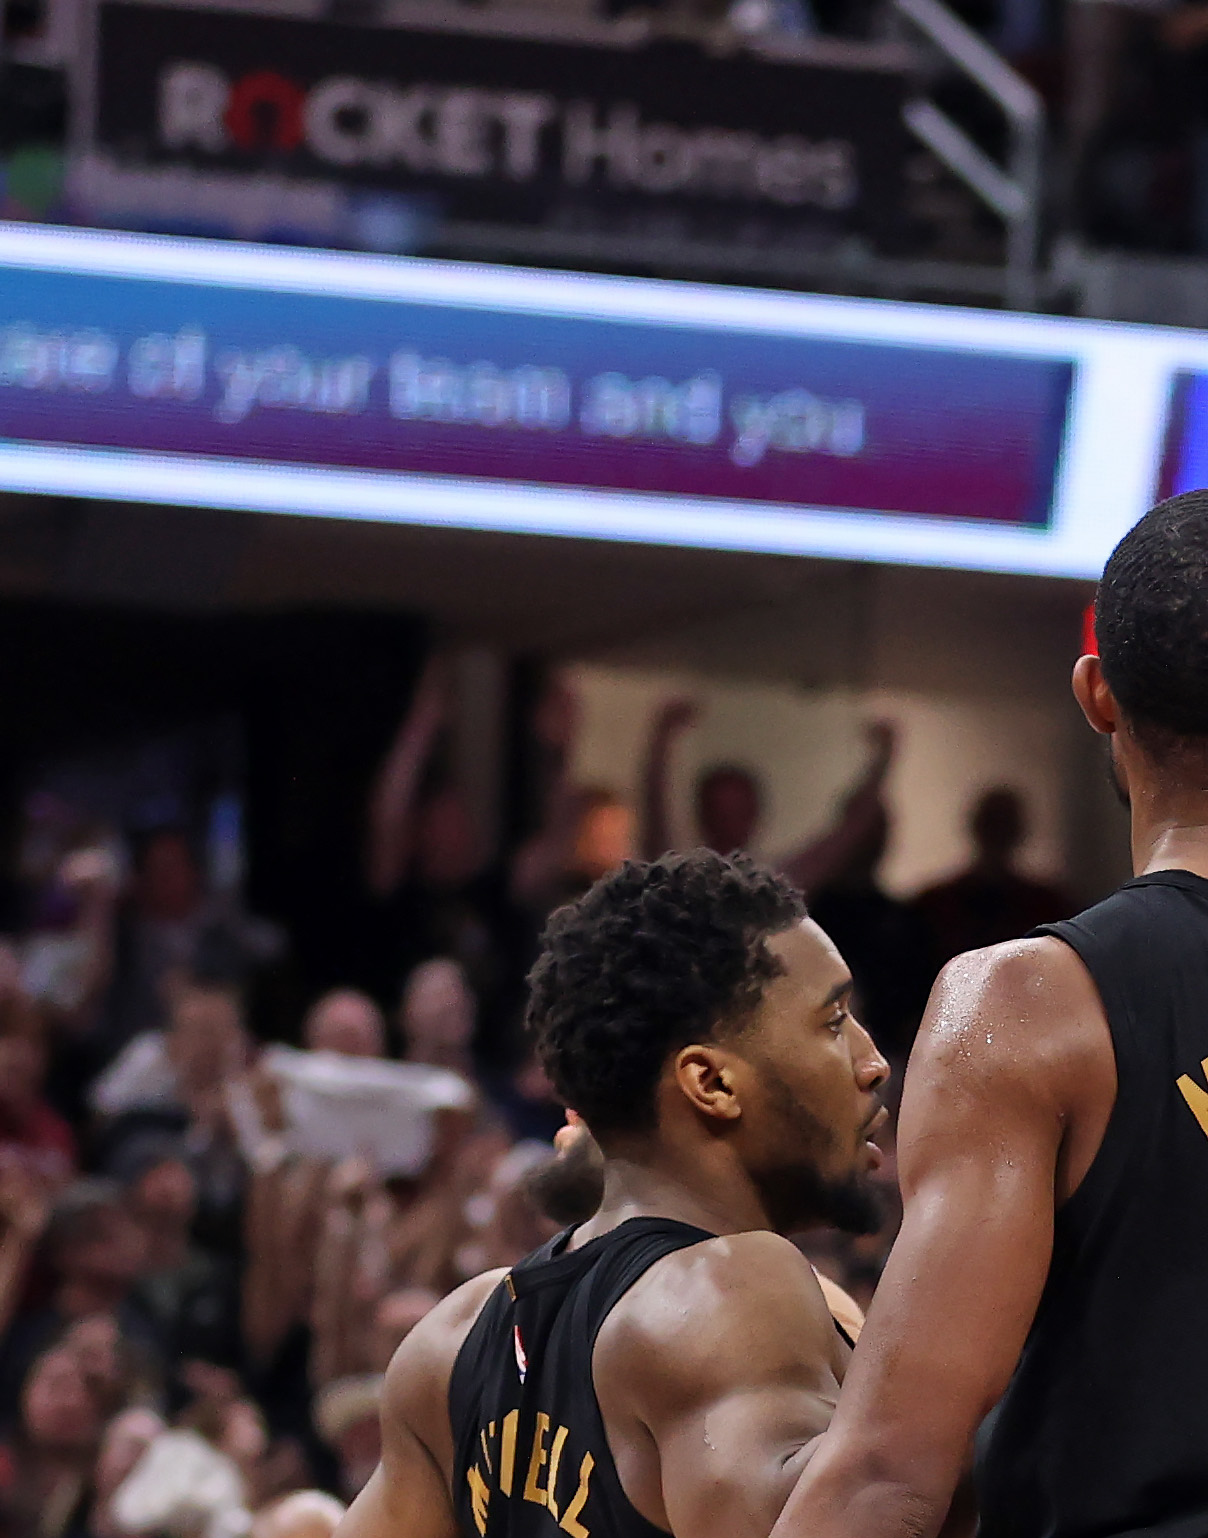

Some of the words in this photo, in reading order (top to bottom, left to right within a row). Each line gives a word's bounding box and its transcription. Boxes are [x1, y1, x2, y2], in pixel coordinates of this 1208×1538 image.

[158, 60, 557, 180] ROCKET
[561, 101, 855, 198] Homes
[127, 324, 206, 401] of
[214, 344, 372, 424] your
[389, 348, 571, 431] team
[580, 367, 722, 446] and
[729, 386, 867, 467] you
